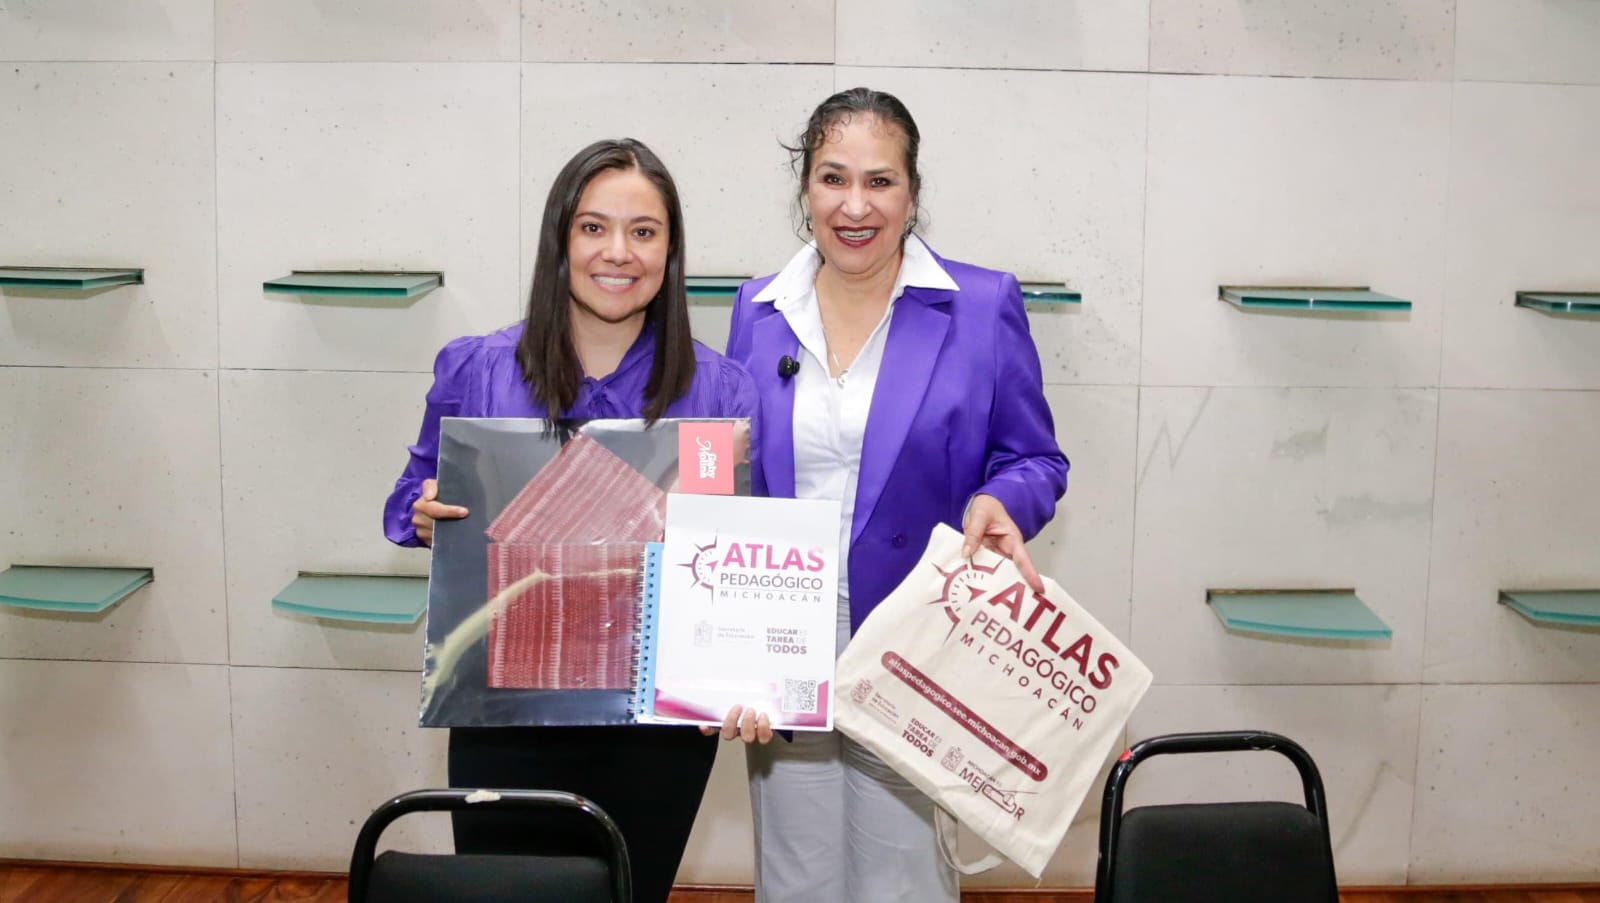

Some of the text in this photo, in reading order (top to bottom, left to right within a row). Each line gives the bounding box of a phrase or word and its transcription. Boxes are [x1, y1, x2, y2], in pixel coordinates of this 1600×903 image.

[722, 542, 825, 573] ATLAS
[720, 572, 823, 591] PEDAGÓGICO
[720, 590, 821, 603] MICHOACÁN
[766, 627, 798, 635] EDUCAR
[766, 635, 794, 644] TAREA
[988, 581, 1120, 690] ATLAS
[767, 644, 807, 655] TODOS
[970, 610, 1097, 714] PEDAGÓGICO
[960, 633, 1084, 730] MICHOACÁN
[907, 723, 928, 743] TAREA
[911, 718, 935, 738] EDUCAR
[902, 730, 934, 757] TODOS
